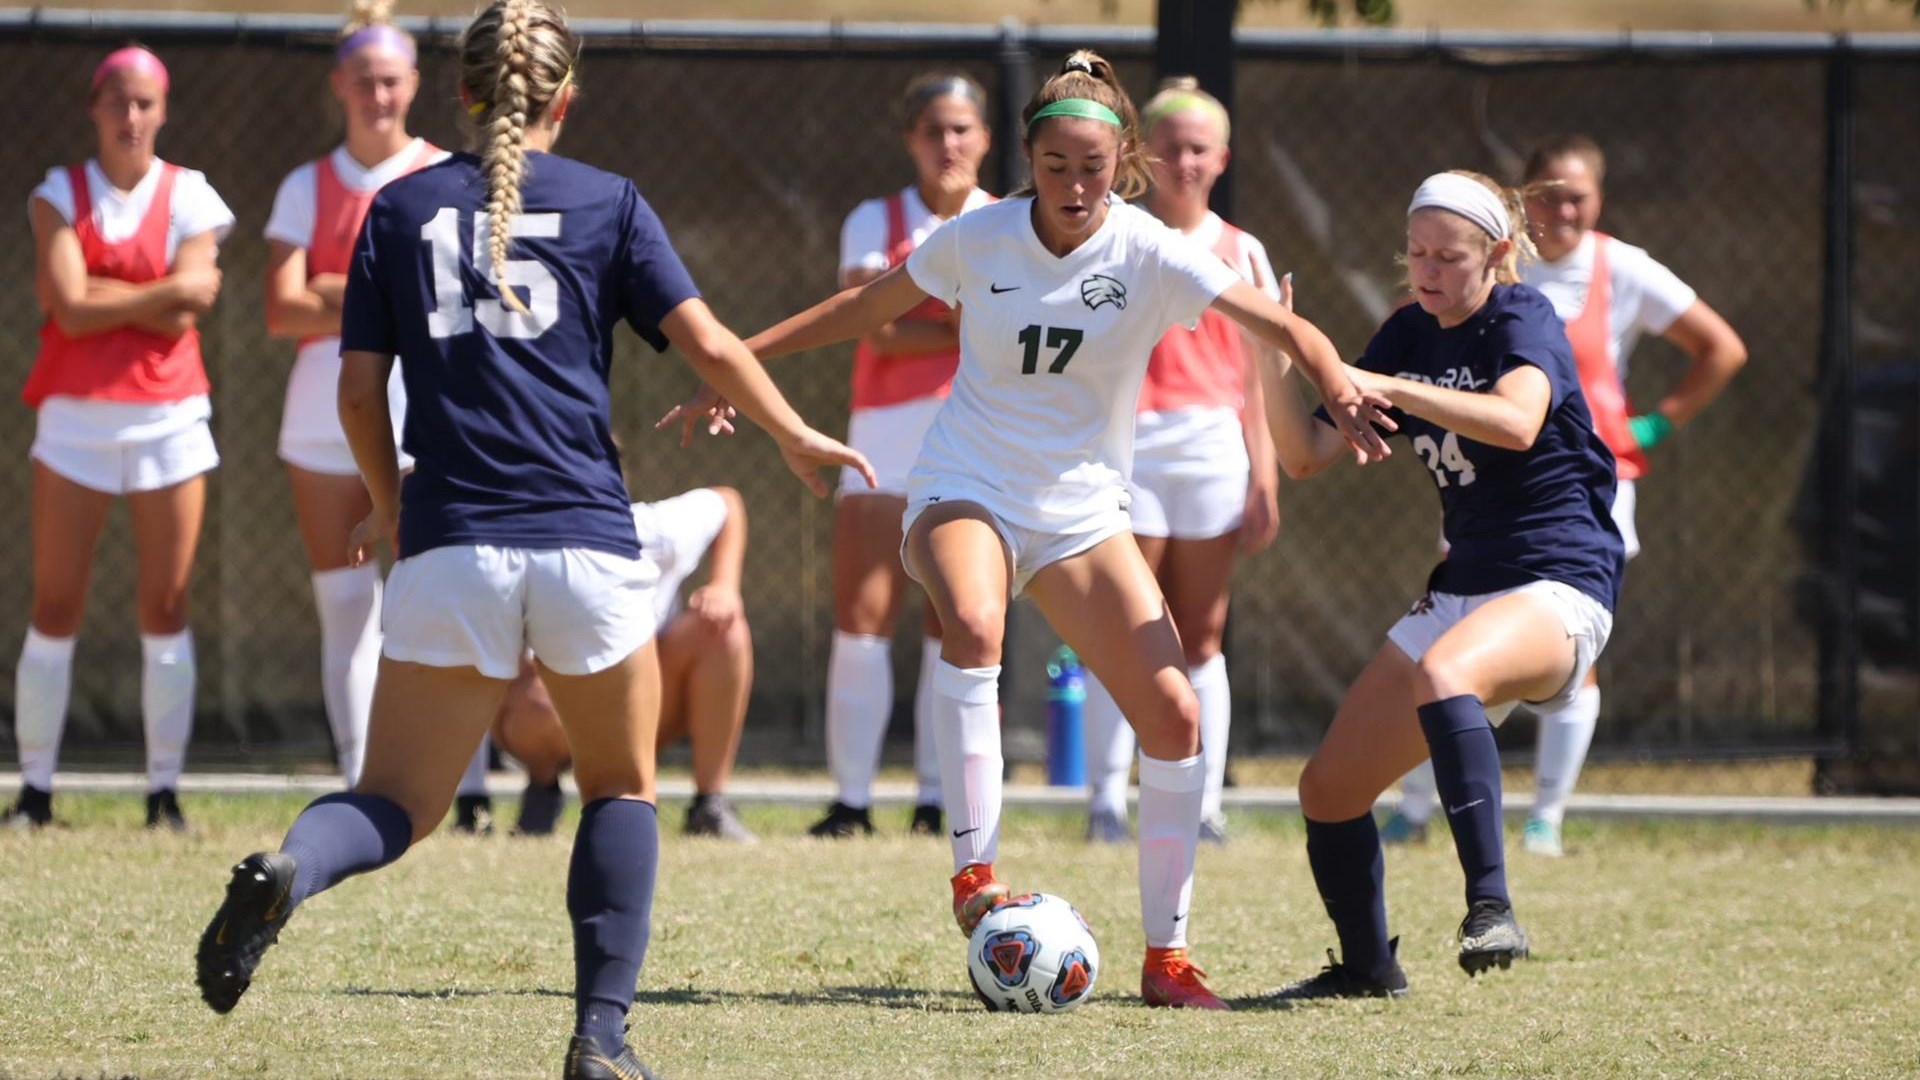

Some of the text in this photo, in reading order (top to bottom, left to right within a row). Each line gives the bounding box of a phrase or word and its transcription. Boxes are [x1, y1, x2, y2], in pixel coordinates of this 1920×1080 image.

[421, 207, 561, 338] 15
[1018, 324, 1083, 374] 17
[1414, 431, 1476, 487] 24
